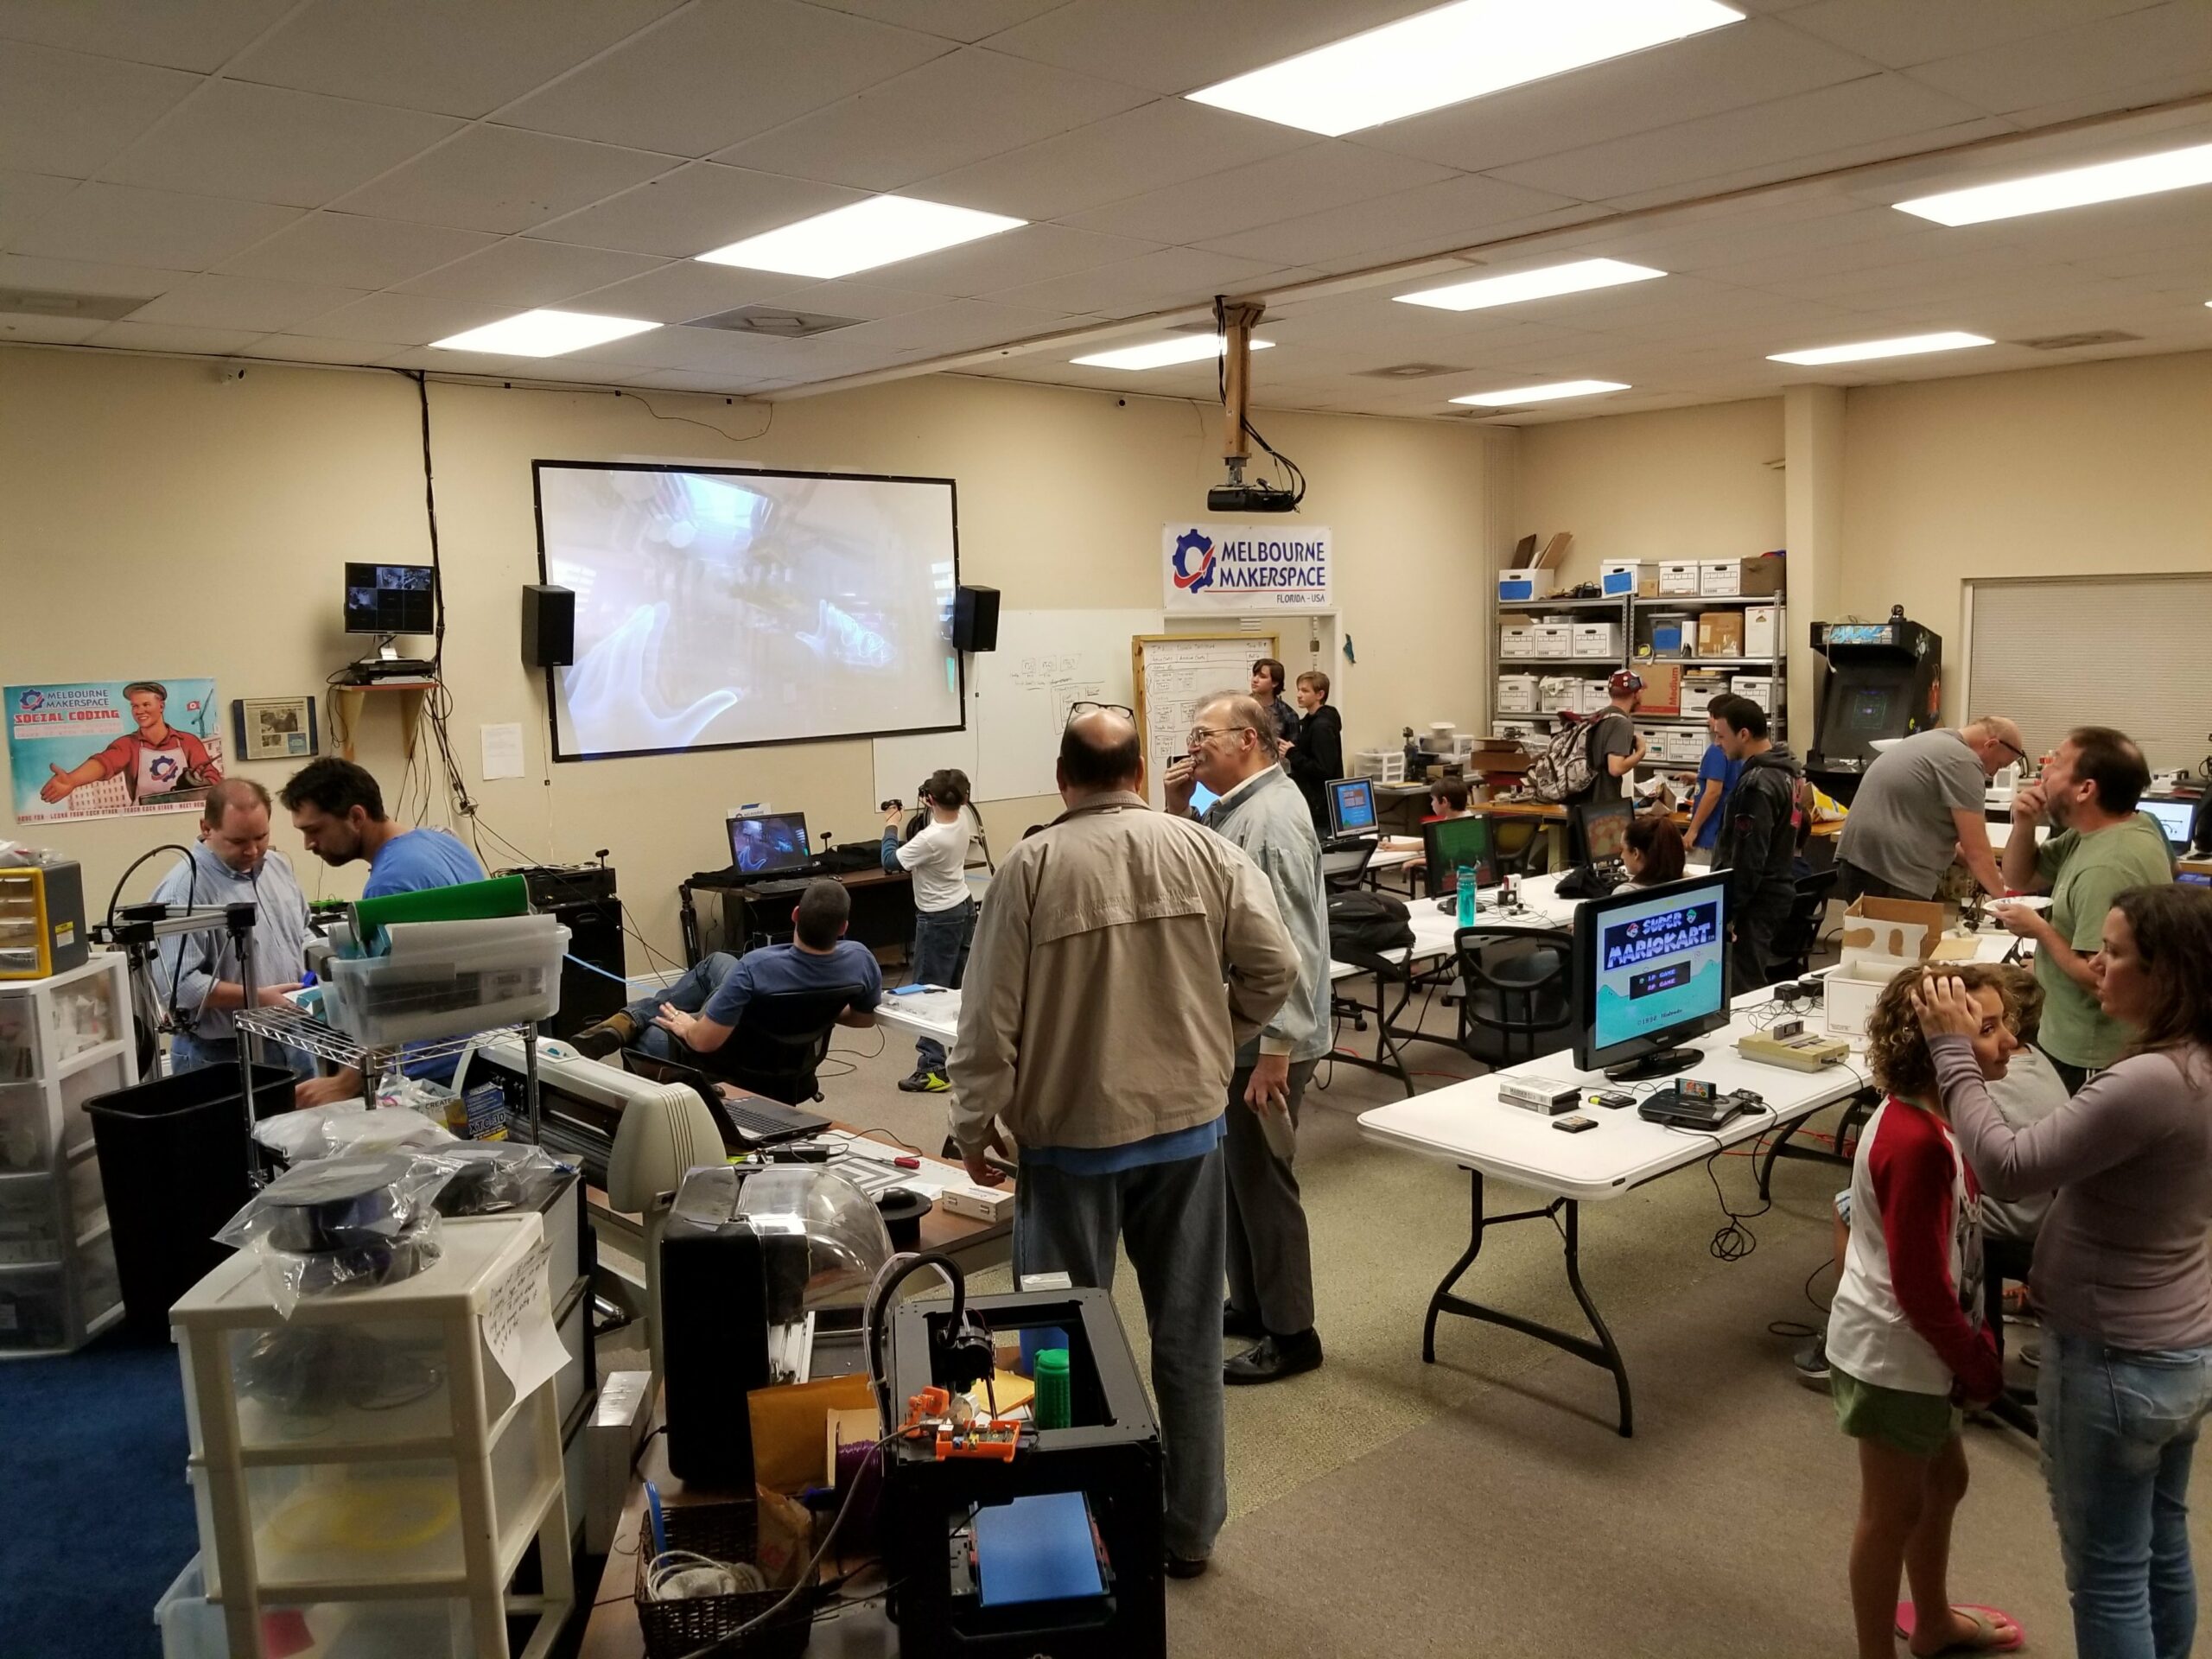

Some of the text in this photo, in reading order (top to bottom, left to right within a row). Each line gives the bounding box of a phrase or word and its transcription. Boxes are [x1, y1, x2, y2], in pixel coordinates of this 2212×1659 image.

[1221, 541, 1325, 562] MELBOURNE
[1219, 567, 1325, 588] MAKERSPACE
[1276, 594, 1306, 604] FLORIDA
[1311, 594, 1325, 603] USA
[1669, 667, 1679, 706] Medium
[47, 690, 109, 699] MELBOURNE
[46, 698, 110, 708] MAKERSPACE
[14, 709, 120, 724] SOCIAL CODING
[1643, 912, 1682, 935] SUPER
[1659, 969, 1676, 979] GAME
[1659, 978, 1676, 988] GAME
[425, 1097, 453, 1109] CREATE
